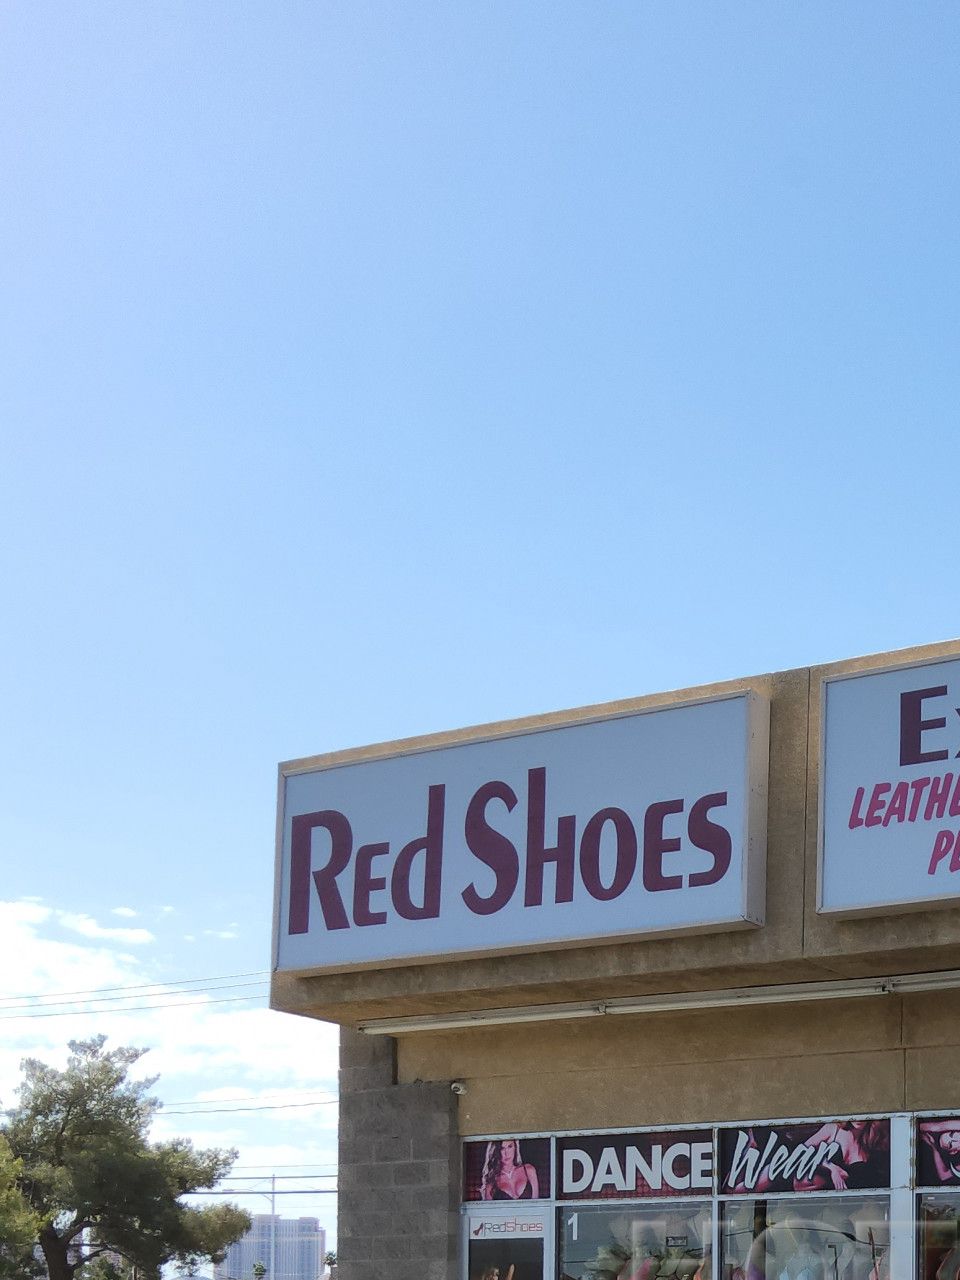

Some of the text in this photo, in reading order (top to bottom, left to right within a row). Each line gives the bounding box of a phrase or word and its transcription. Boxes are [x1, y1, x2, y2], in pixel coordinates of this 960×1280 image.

[562, 1130, 840, 1193] DANCE Wear
[567, 1212, 579, 1241] 1
